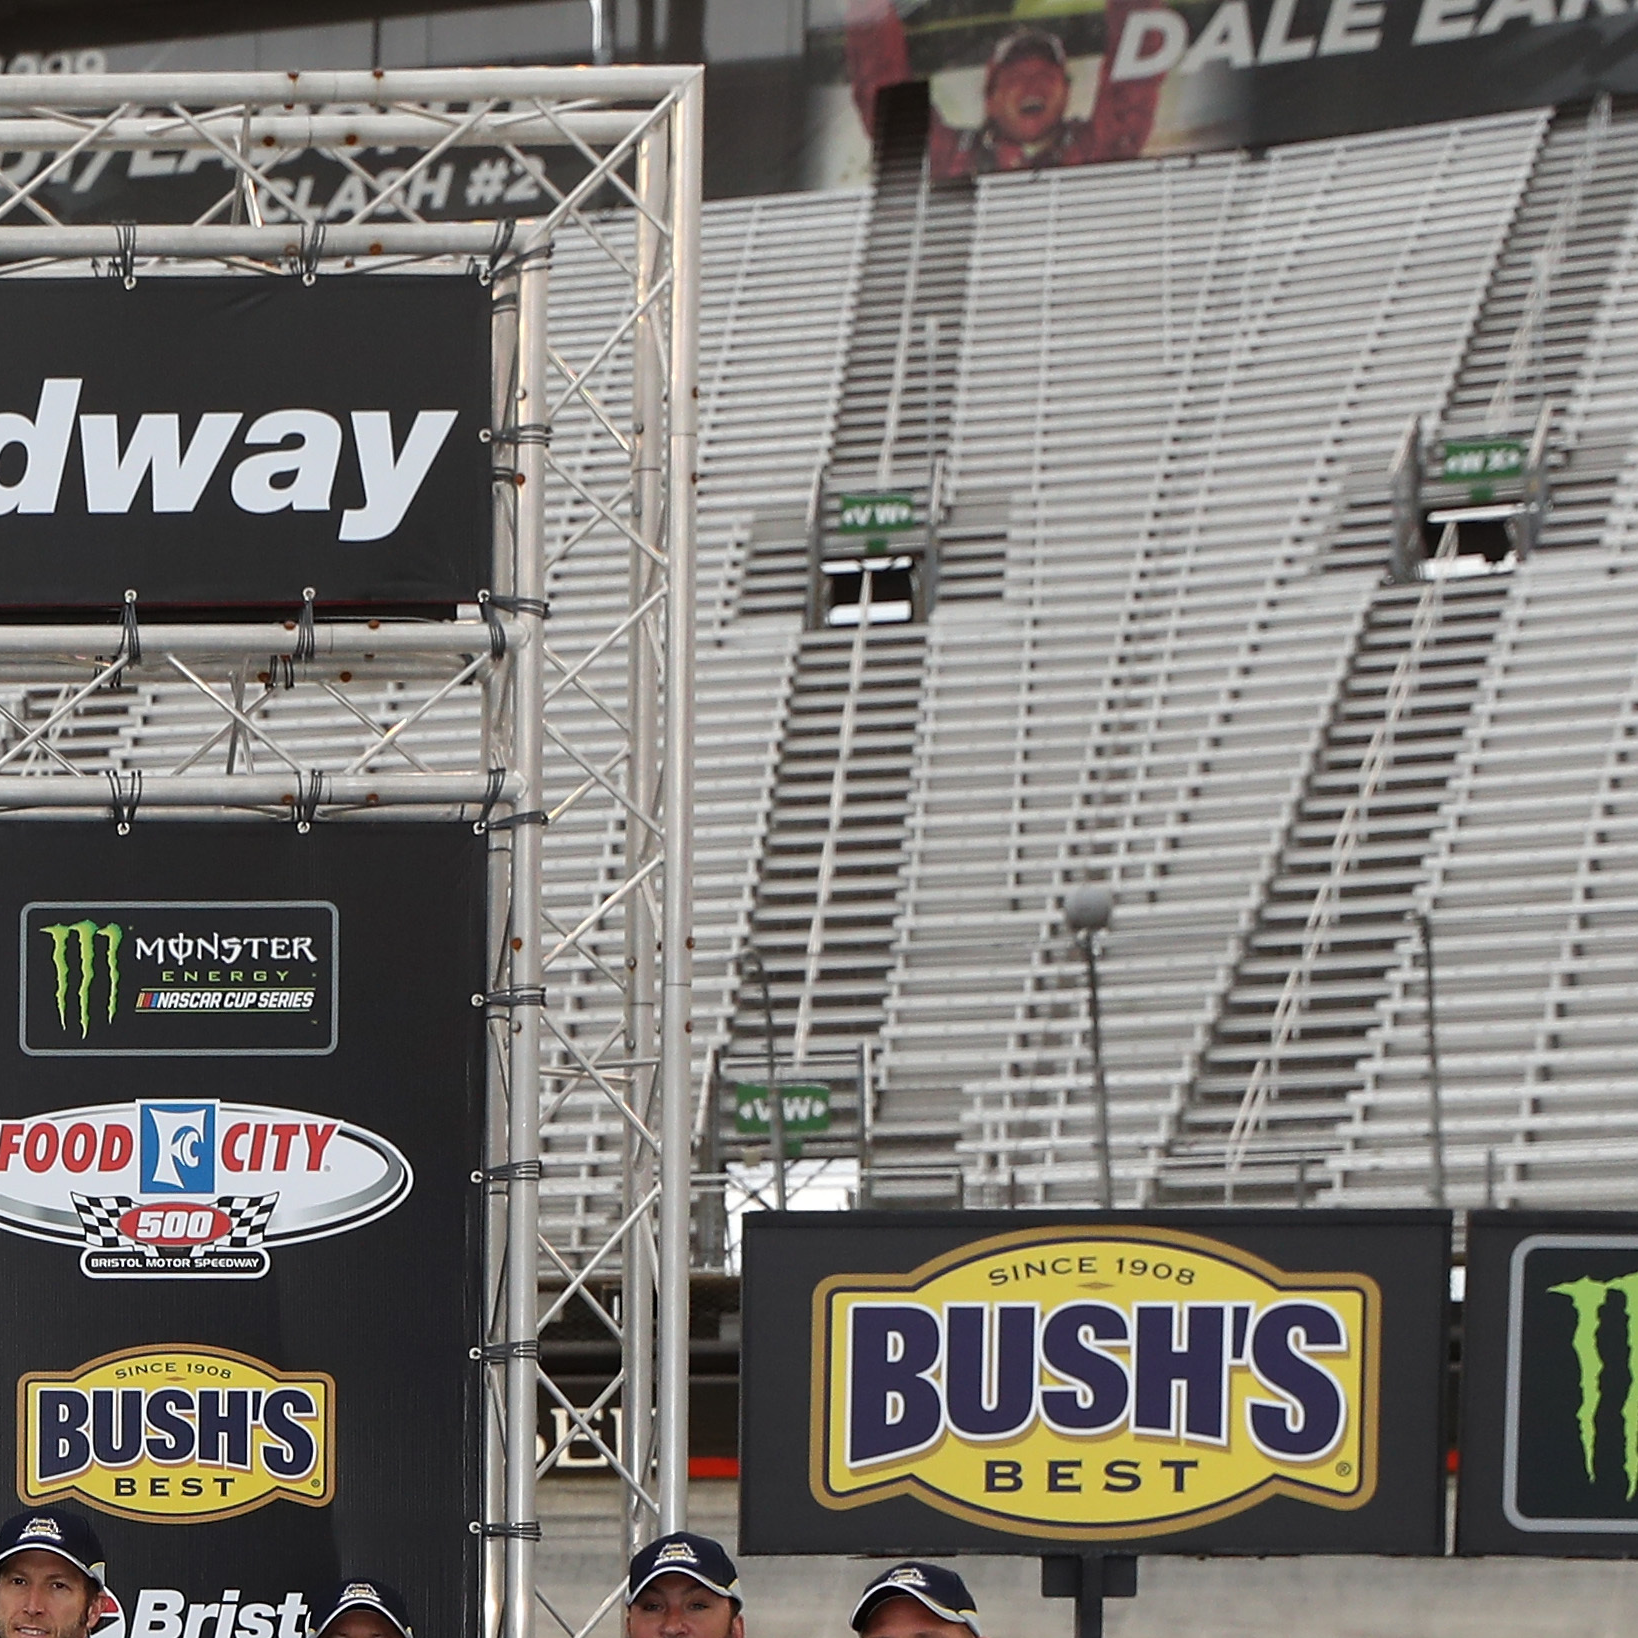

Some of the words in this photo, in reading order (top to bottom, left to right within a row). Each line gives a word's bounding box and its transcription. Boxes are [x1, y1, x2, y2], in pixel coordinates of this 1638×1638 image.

[1111, 0, 1383, 82] DALE
[252, 164, 452, 224] CLASH
[464, 154, 546, 204] #2
[135, 932, 317, 966] MONSTER
[162, 970, 289, 982] ENERGY
[156, 992, 222, 1009] NASCAR
[223, 992, 257, 1009] CUP
[257, 991, 314, 1009] SERIES
[221, 1122, 337, 1173] CITY
[136, 1210, 214, 1239] 500
[91, 1257, 142, 1269] BRISTOL
[145, 1257, 191, 1269] MOTOR
[194, 1257, 259, 1270] SPEEDWAY
[986, 1255, 1098, 1288] SINCE
[1115, 1256, 1196, 1287] 1908
[115, 1362, 177, 1380] SINCE
[185, 1363, 232, 1379] 1908
[845, 1298, 1350, 1469] BUSH'S
[36, 1387, 319, 1484] BUSH'S
[113, 1477, 236, 1498] BEST
[983, 1460, 1199, 1494] BEST
